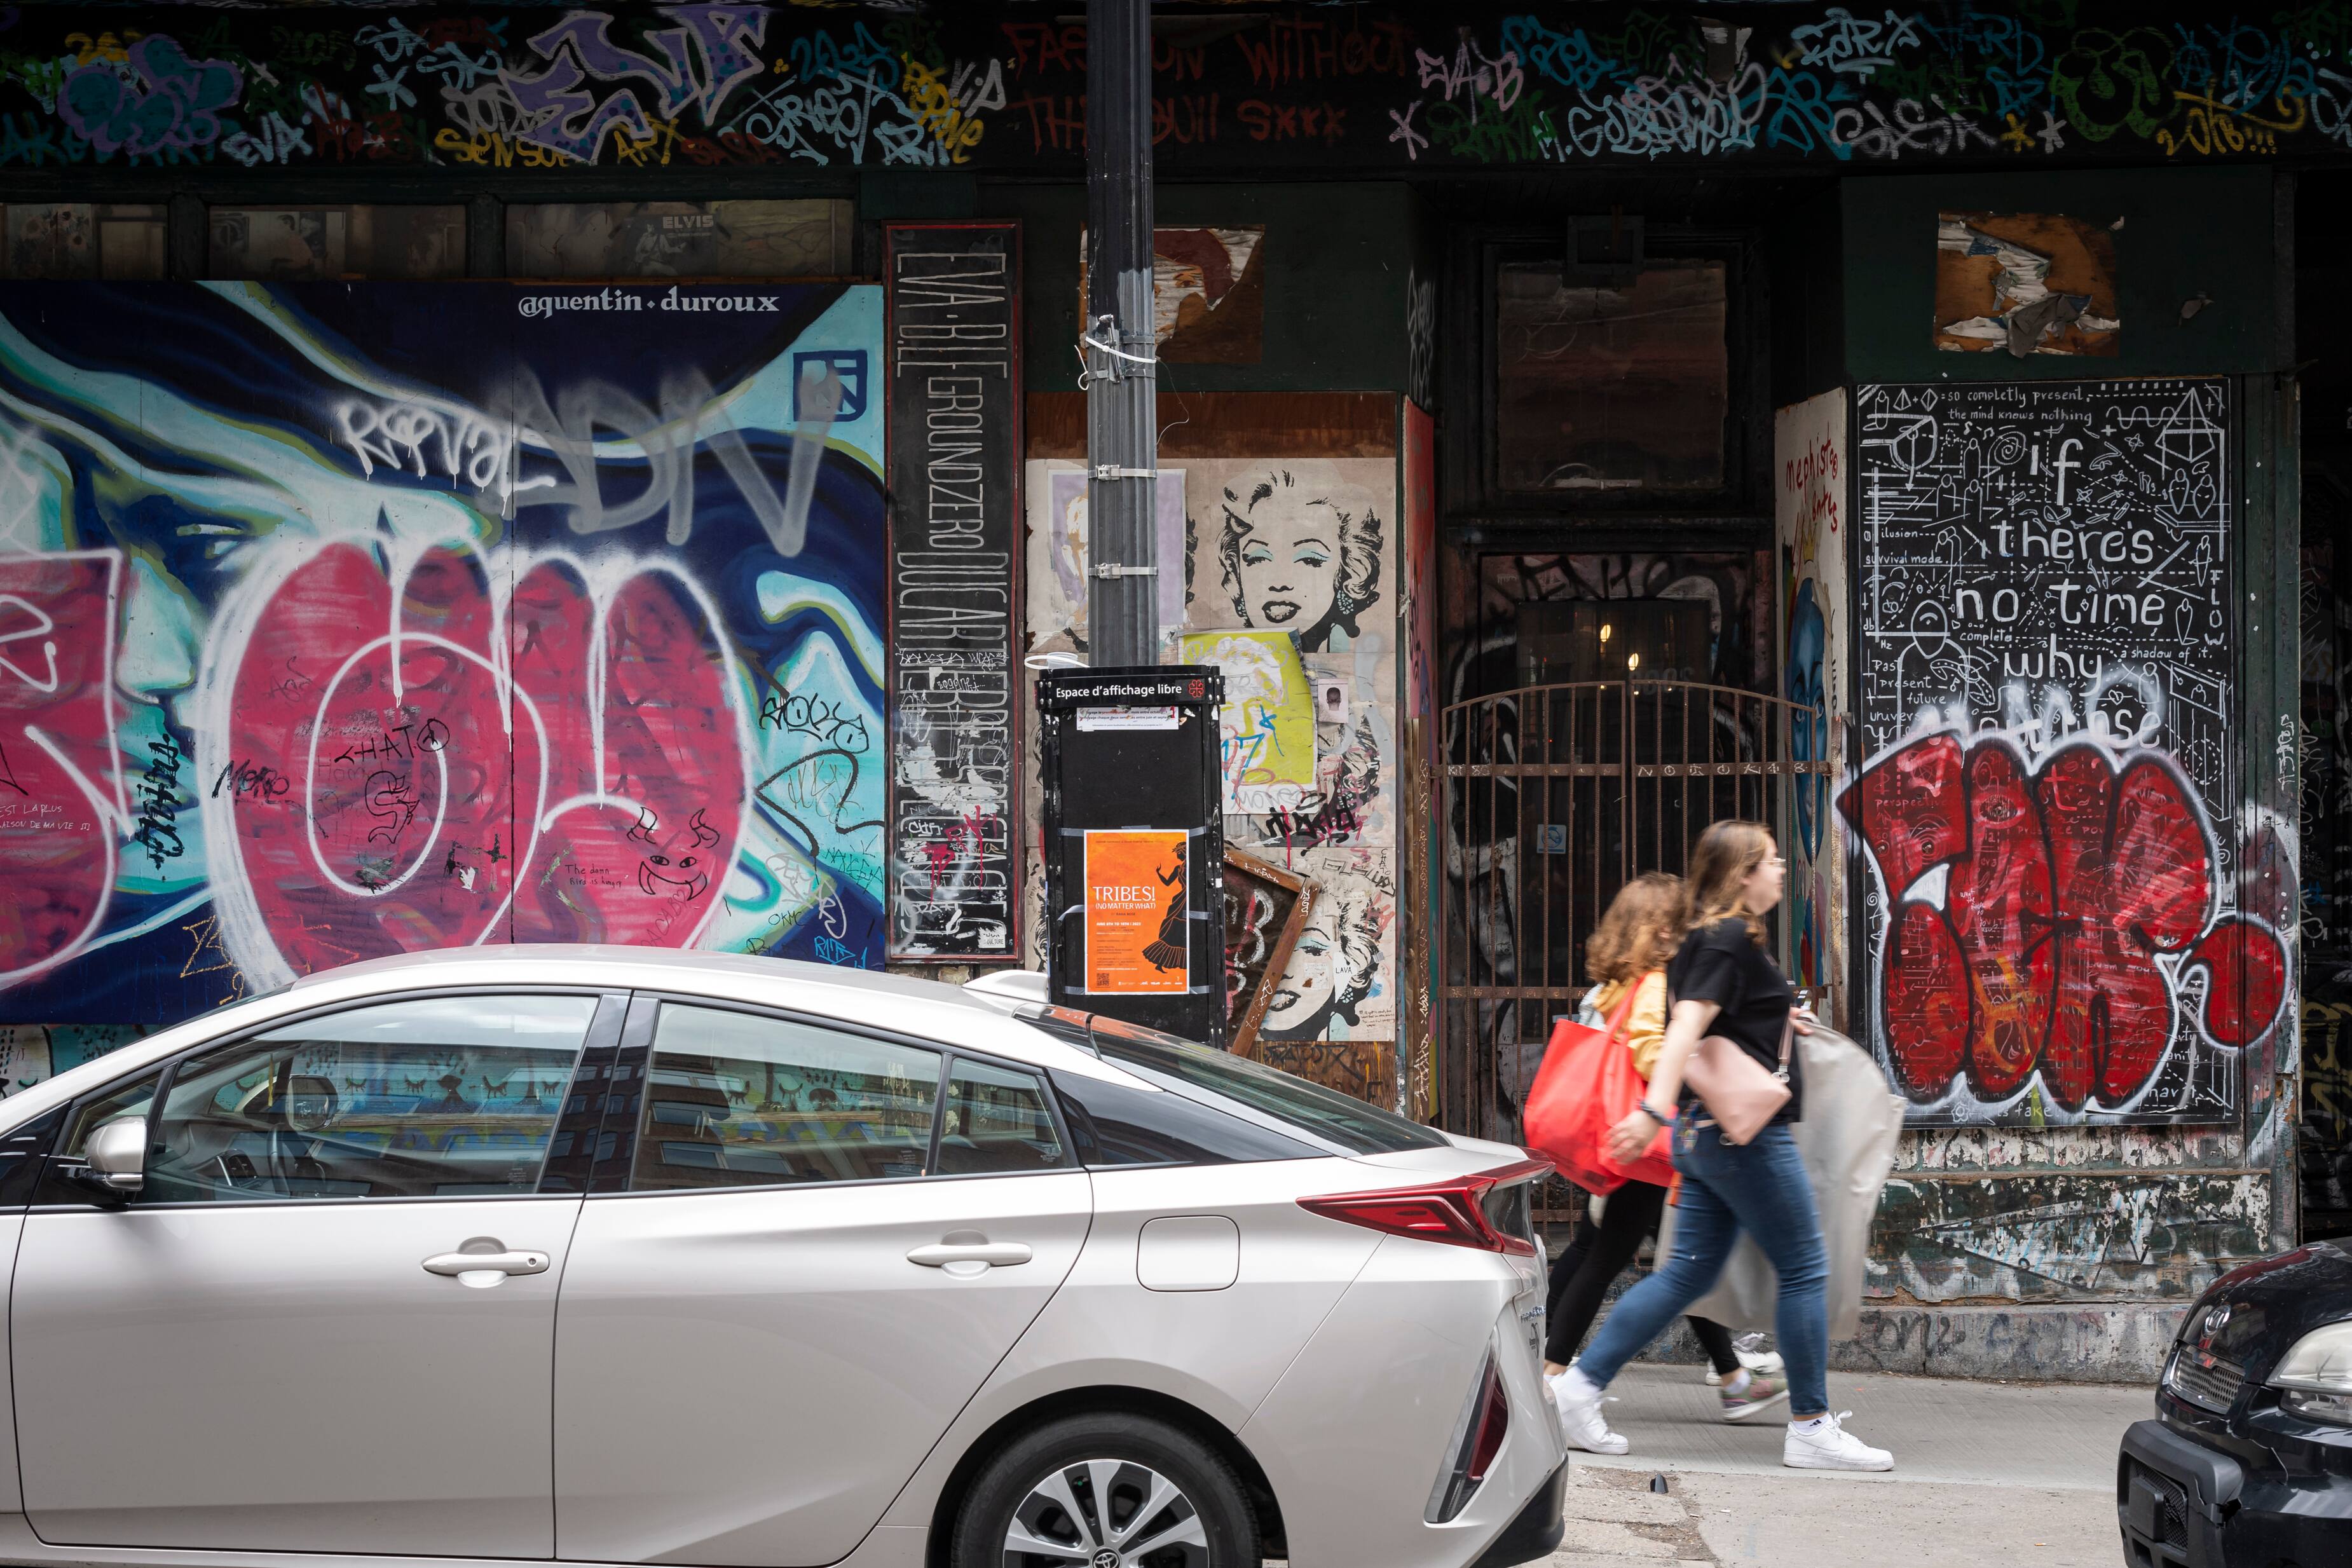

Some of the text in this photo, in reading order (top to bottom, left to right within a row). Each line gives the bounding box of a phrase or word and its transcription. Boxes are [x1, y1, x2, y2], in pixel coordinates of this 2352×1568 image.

[663, 215, 714, 229] ELVIS
[518, 285, 780, 319] @quentin duroux
[1948, 406, 2092, 426] the mind knows nothing
[1866, 550, 1908, 564] survival
[1956, 578, 2166, 625] no time
[2131, 645, 2171, 658] shadow
[2004, 633, 2102, 697] why
[1056, 687, 1090, 699] Espace
[1158, 683, 1182, 694] libre
[1906, 692, 1946, 705] future
[0, 821, 26, 829] AISON
[564, 864, 610, 875] The damn
[601, 876, 622, 889] hungry
[1092, 886, 1156, 901] TRIBES!
